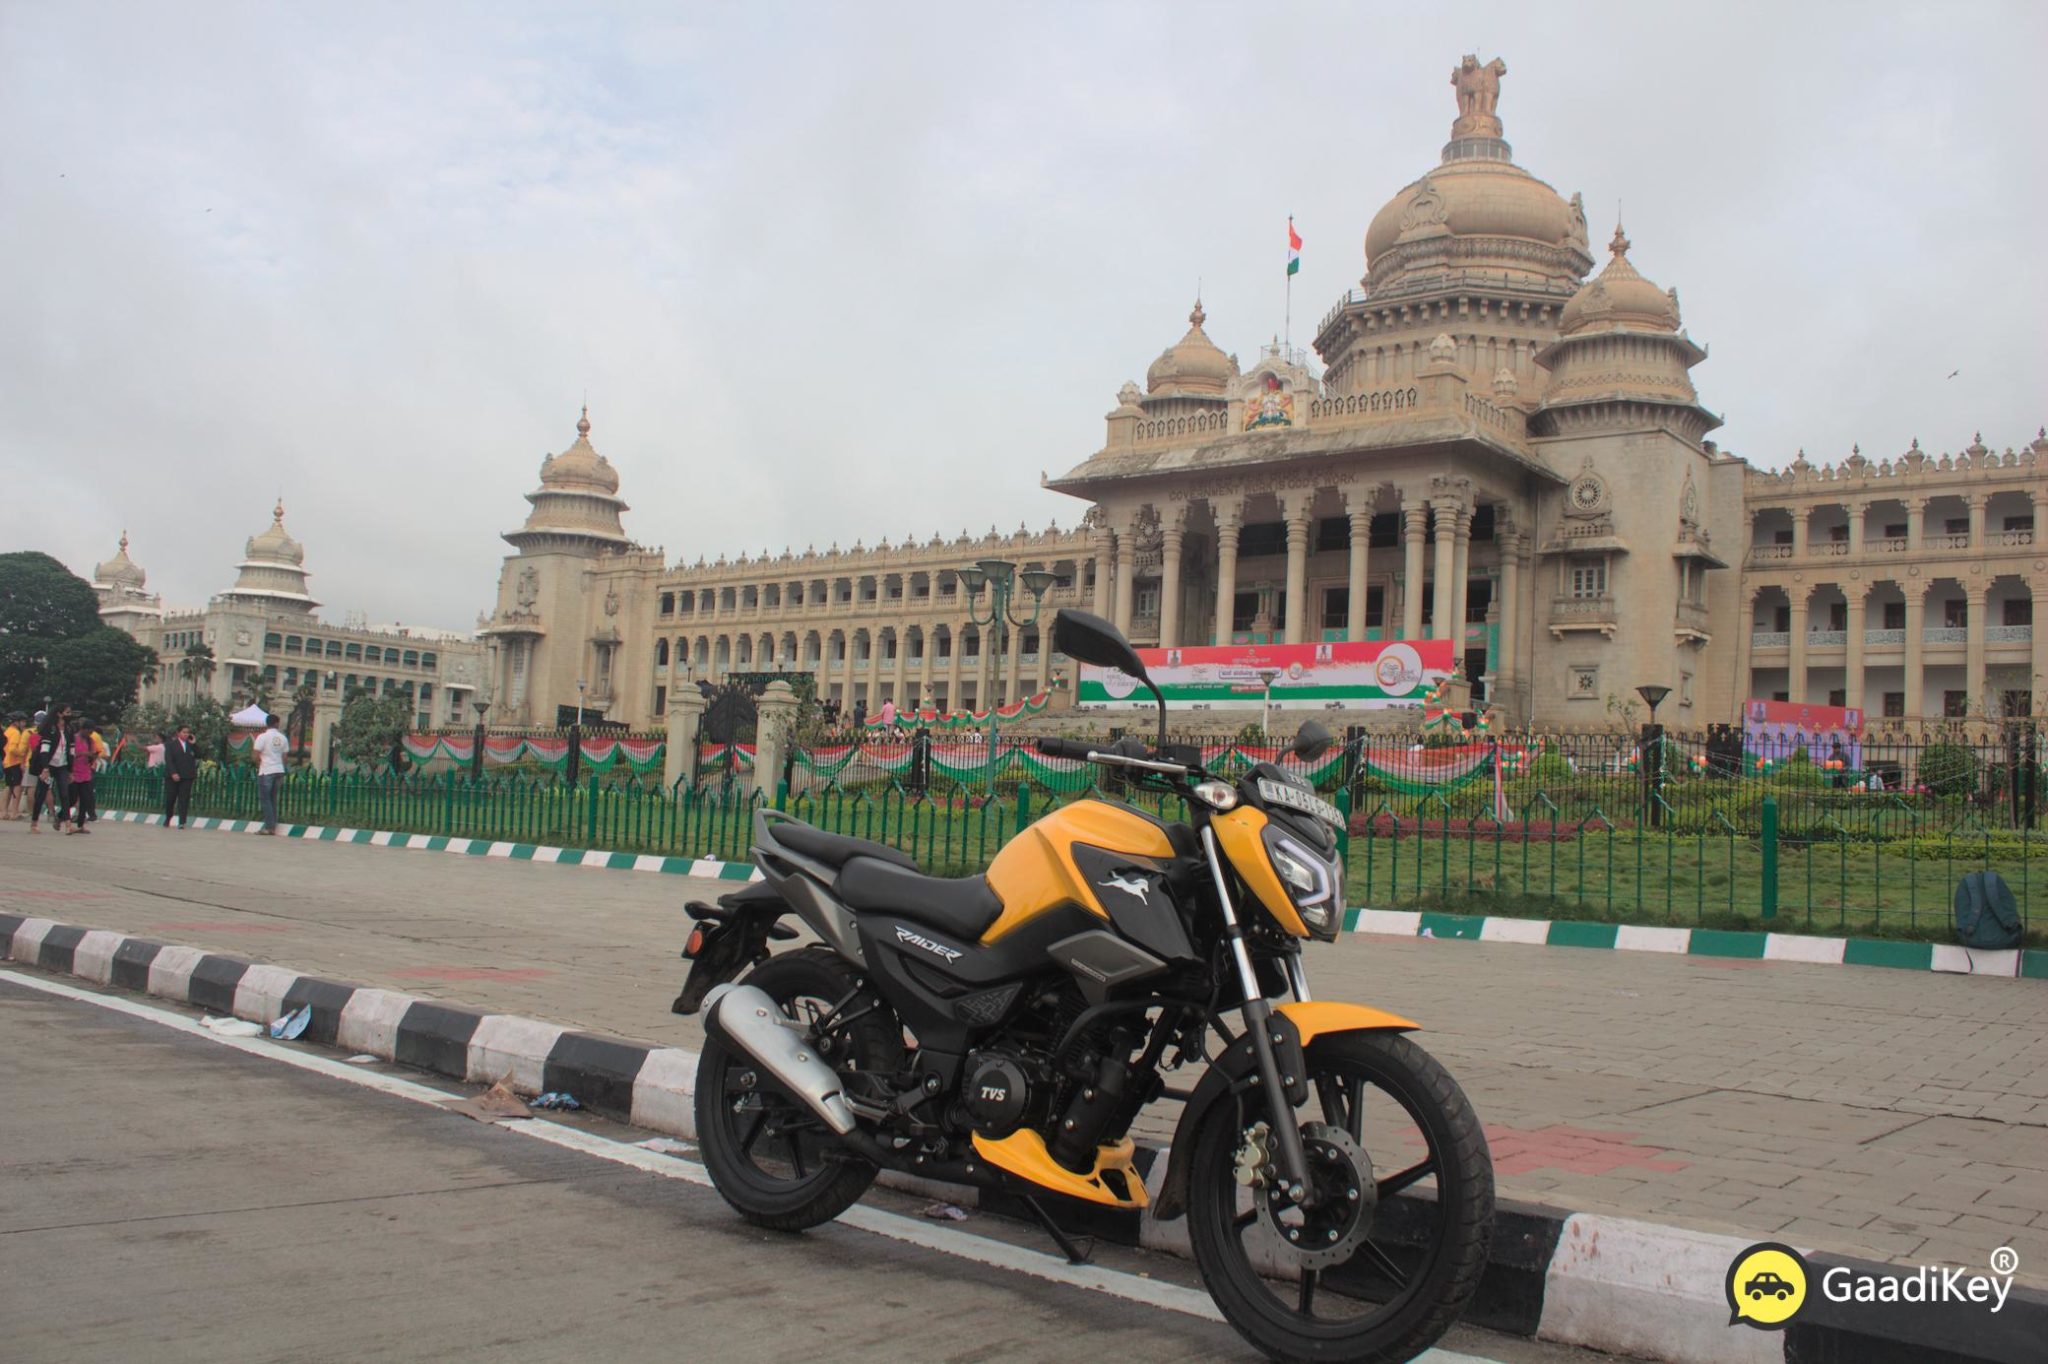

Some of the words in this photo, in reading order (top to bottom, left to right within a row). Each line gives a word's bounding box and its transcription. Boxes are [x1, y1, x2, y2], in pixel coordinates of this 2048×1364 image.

[1169, 486, 1239, 501] GOVERNMENT
[1245, 481, 1274, 493] WORK
[1276, 478, 1285, 489] IS
[895, 925, 963, 964] RAIDER
[981, 1086, 1006, 1102] TVS
